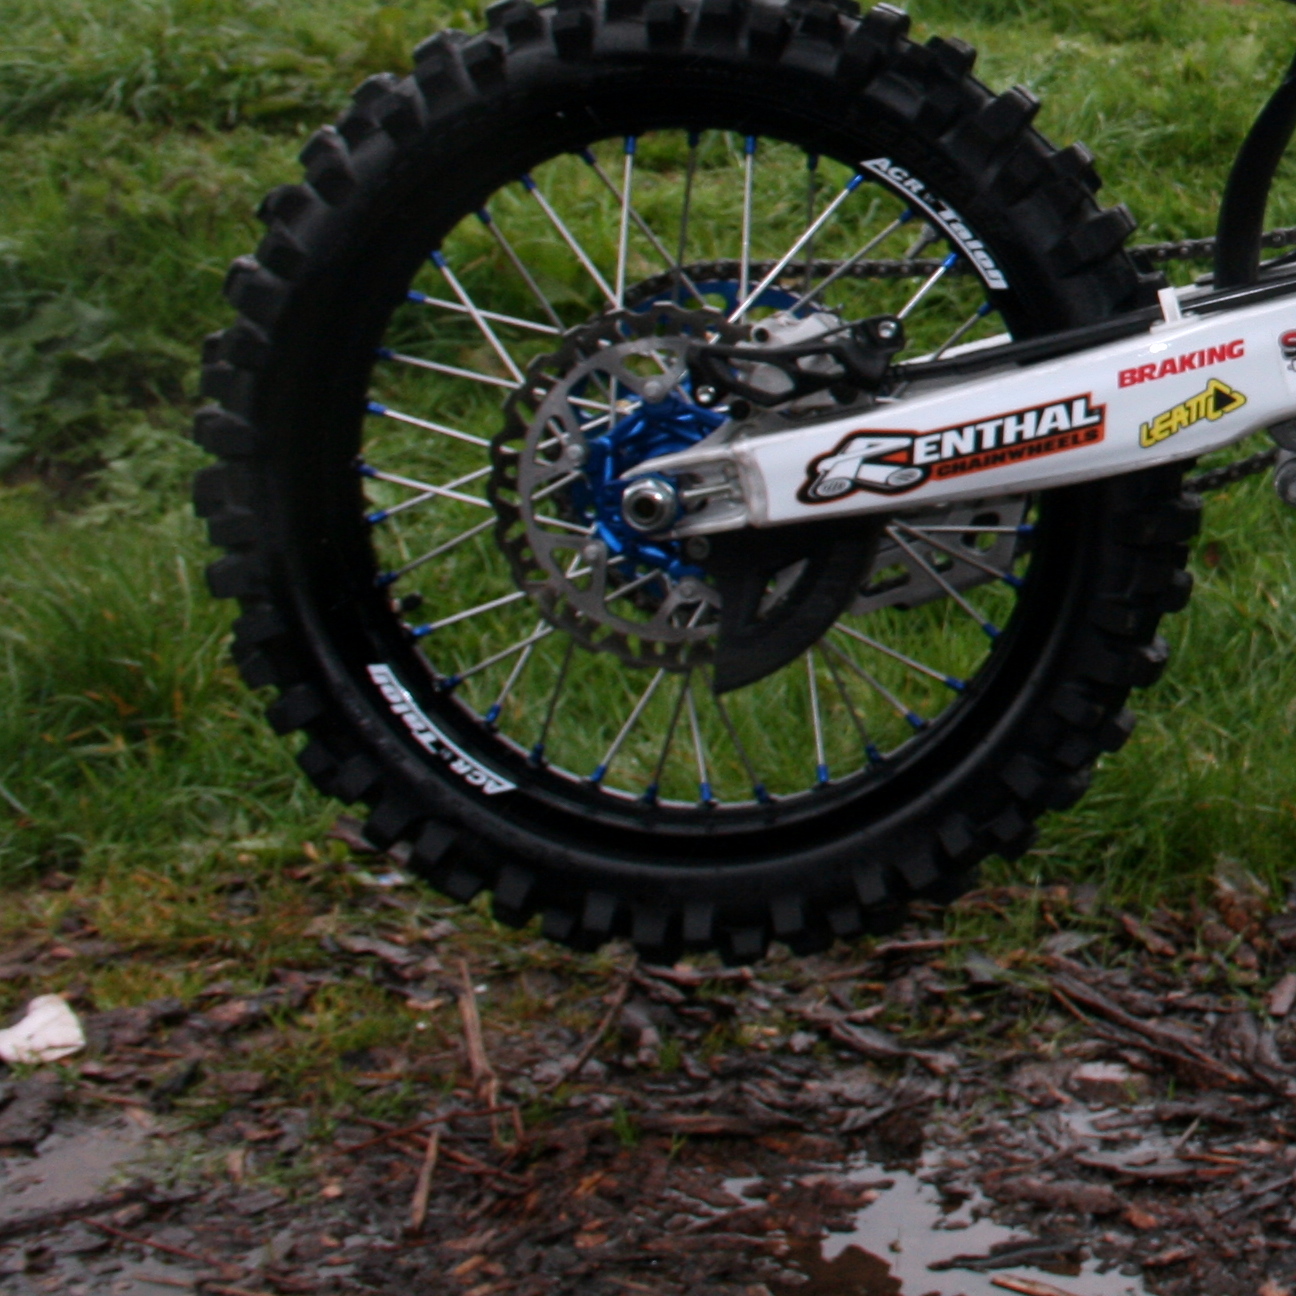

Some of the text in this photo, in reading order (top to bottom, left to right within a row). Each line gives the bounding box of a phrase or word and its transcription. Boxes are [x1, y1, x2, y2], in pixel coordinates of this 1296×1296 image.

[1118, 339, 1244, 389] BRAKING
[1139, 378, 1246, 448] LEATT
[936, 429, 1100, 479] CHAINWHEELS
